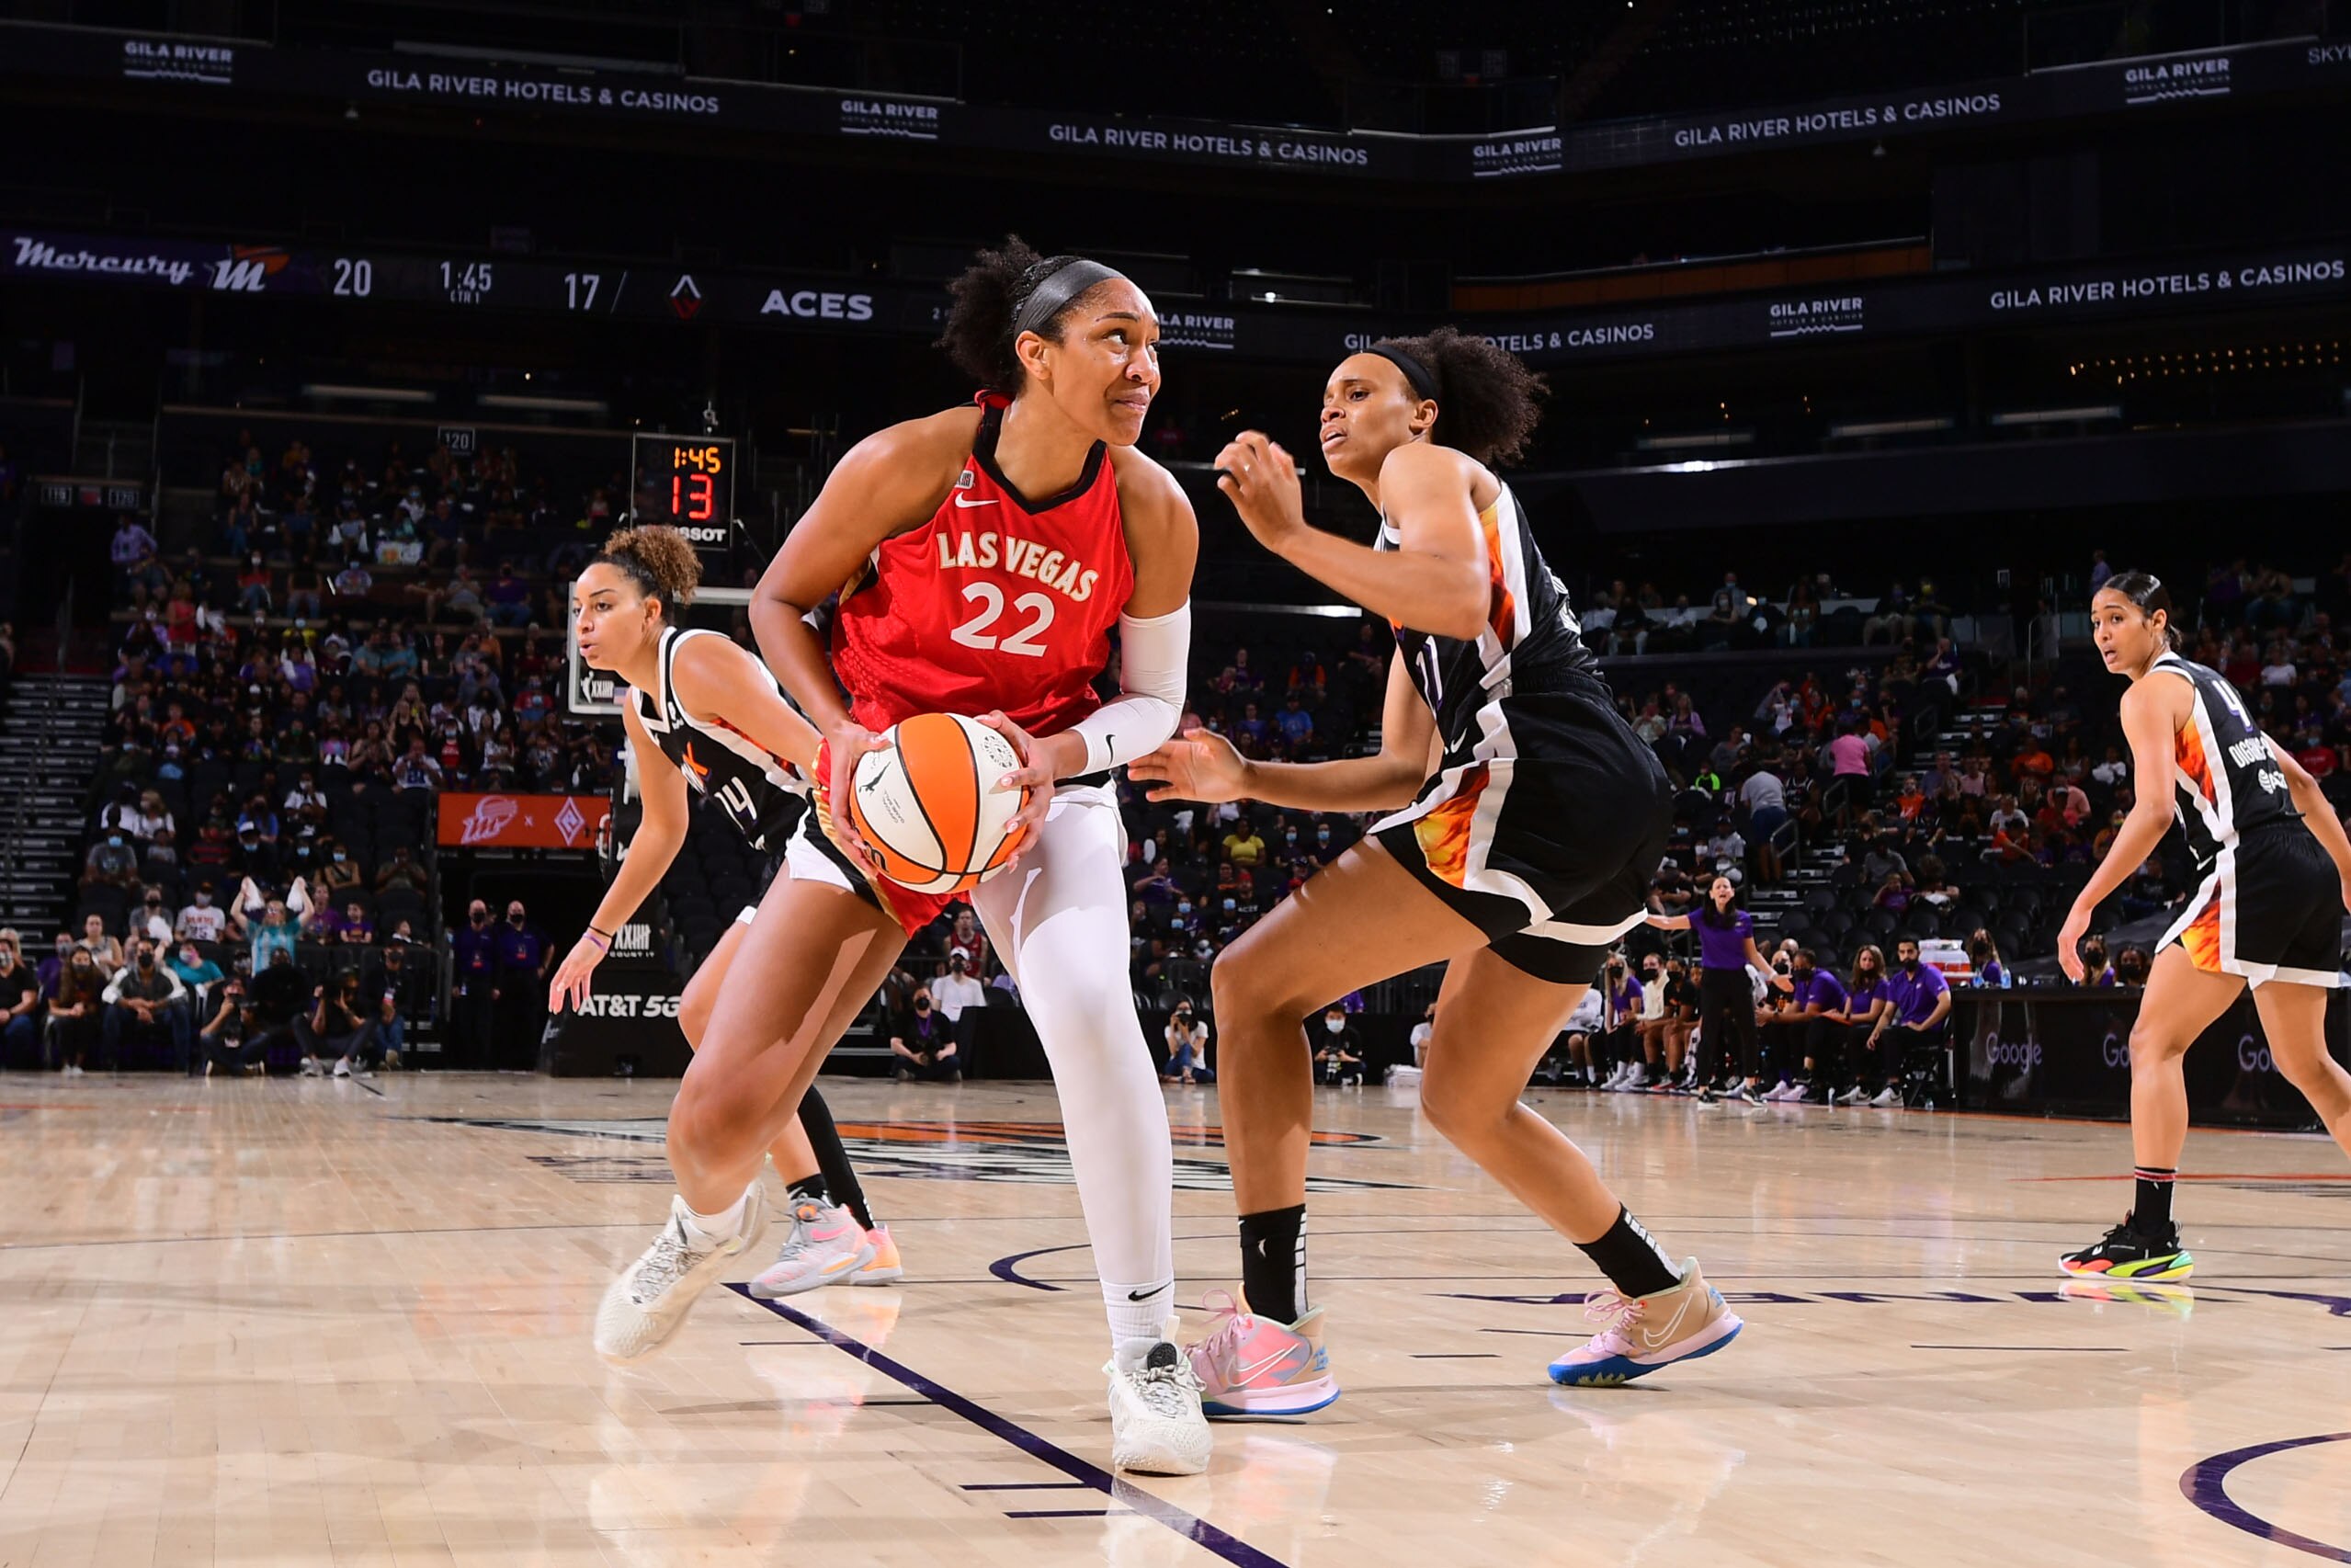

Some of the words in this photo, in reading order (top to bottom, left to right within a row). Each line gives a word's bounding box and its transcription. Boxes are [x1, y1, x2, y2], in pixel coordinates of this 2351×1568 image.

[122, 40, 171, 59] GILA
[173, 44, 233, 63] RIVER
[2124, 64, 2170, 85] GILA
[2171, 57, 2231, 77] RIVER
[368, 69, 422, 90] GILA
[429, 74, 498, 96] RIVER
[505, 80, 592, 103] HOTELS
[598, 88, 613, 105] &
[620, 90, 719, 113] CASINOS
[840, 99, 883, 116] GILA
[885, 102, 938, 120] RIVER
[1675, 126, 1722, 147] GILA
[1728, 118, 1789, 141] RIVER
[1796, 108, 1877, 133] HOTELS
[1882, 106, 1897, 122] &
[1903, 94, 2001, 120] CASINOS
[1049, 124, 1106, 144] GILA
[1108, 128, 1167, 149] RIVER
[1173, 134, 1253, 156] HOTELS
[1258, 141, 1272, 157] &
[1278, 142, 1368, 165] CASINOS
[1472, 142, 1513, 159] GILA
[1513, 137, 1562, 155] RIVER
[14, 237, 193, 285] Mercury
[334, 258, 371, 297] 20
[439, 260, 493, 292] 1:45
[564, 273, 600, 310] 17
[1990, 289, 2042, 309] GILA
[2049, 281, 2115, 304] RIVER
[2122, 273, 2210, 298] HOTELS
[2217, 270, 2232, 289] &
[2240, 260, 2345, 286] CASINOS
[760, 290, 873, 321] ACES
[1158, 313, 1183, 327] LA
[1184, 313, 1236, 331] RIVER
[1769, 301, 1811, 318] GILA
[1811, 296, 1864, 315] RIVER
[1343, 333, 1376, 352] GIL
[1482, 333, 1545, 354] OTELS
[1549, 332, 1562, 348] &
[1567, 324, 1654, 347] CASINOS
[446, 432, 469, 449] 120
[675, 447, 721, 474] 1:45
[672, 473, 713, 520] 13
[936, 530, 999, 570] LAS
[1005, 535, 1099, 602] VEGAS
[950, 581, 1056, 657] 22
[2211, 678, 2254, 733] 4
[713, 775, 760, 835] 14
[577, 994, 642, 1017] AT&T
[642, 994, 682, 1018] 5G
[1985, 1030, 2043, 1075] Google
